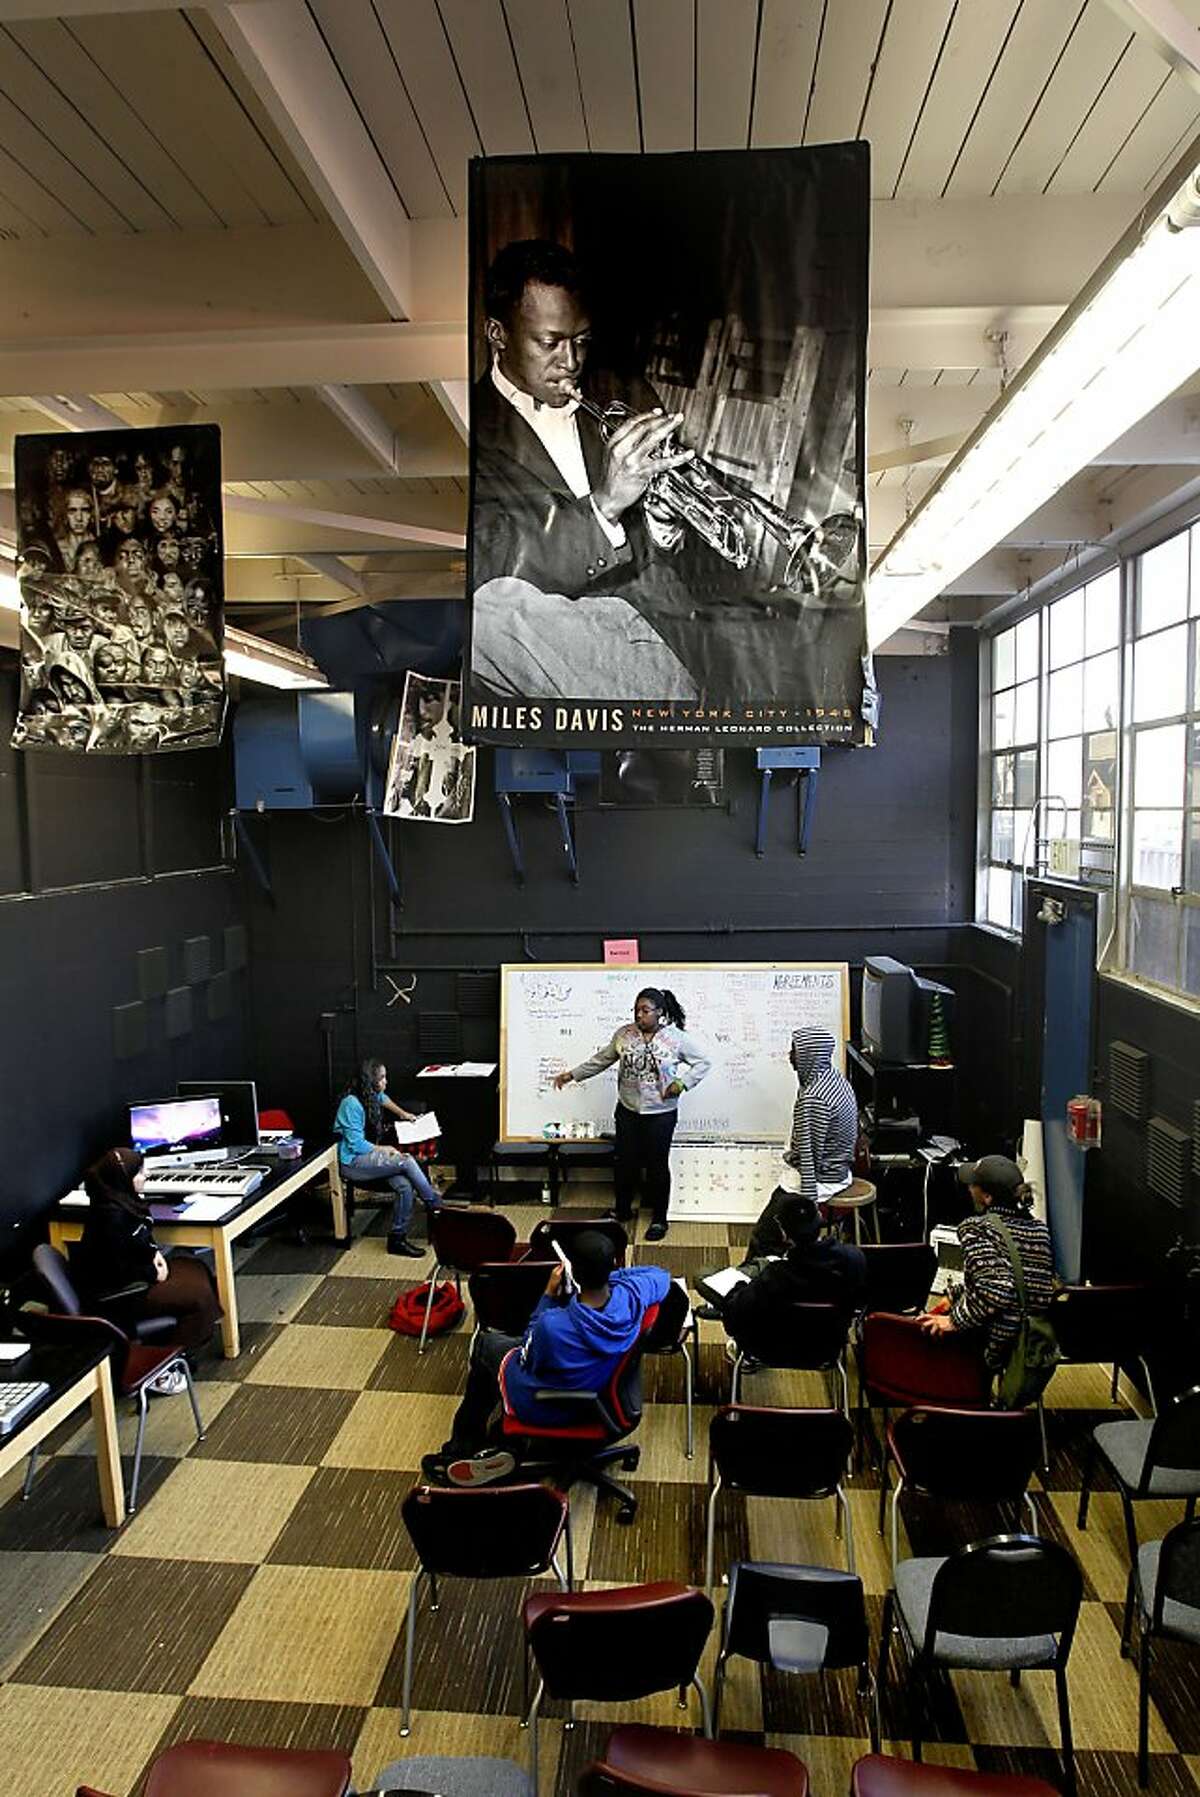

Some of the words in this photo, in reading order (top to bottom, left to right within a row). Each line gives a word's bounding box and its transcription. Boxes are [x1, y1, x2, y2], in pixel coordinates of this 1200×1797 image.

[471, 705, 542, 730] MILES
[555, 708, 624, 732] DAVIS
[632, 708, 670, 718] NEW
[682, 709, 732, 719] YORK
[745, 709, 787, 718] CITY
[632, 724, 654, 733] THE
[660, 725, 710, 733] HERMAN
[714, 725, 772, 733] LEONARD
[776, 724, 853, 733] COLLECTION
